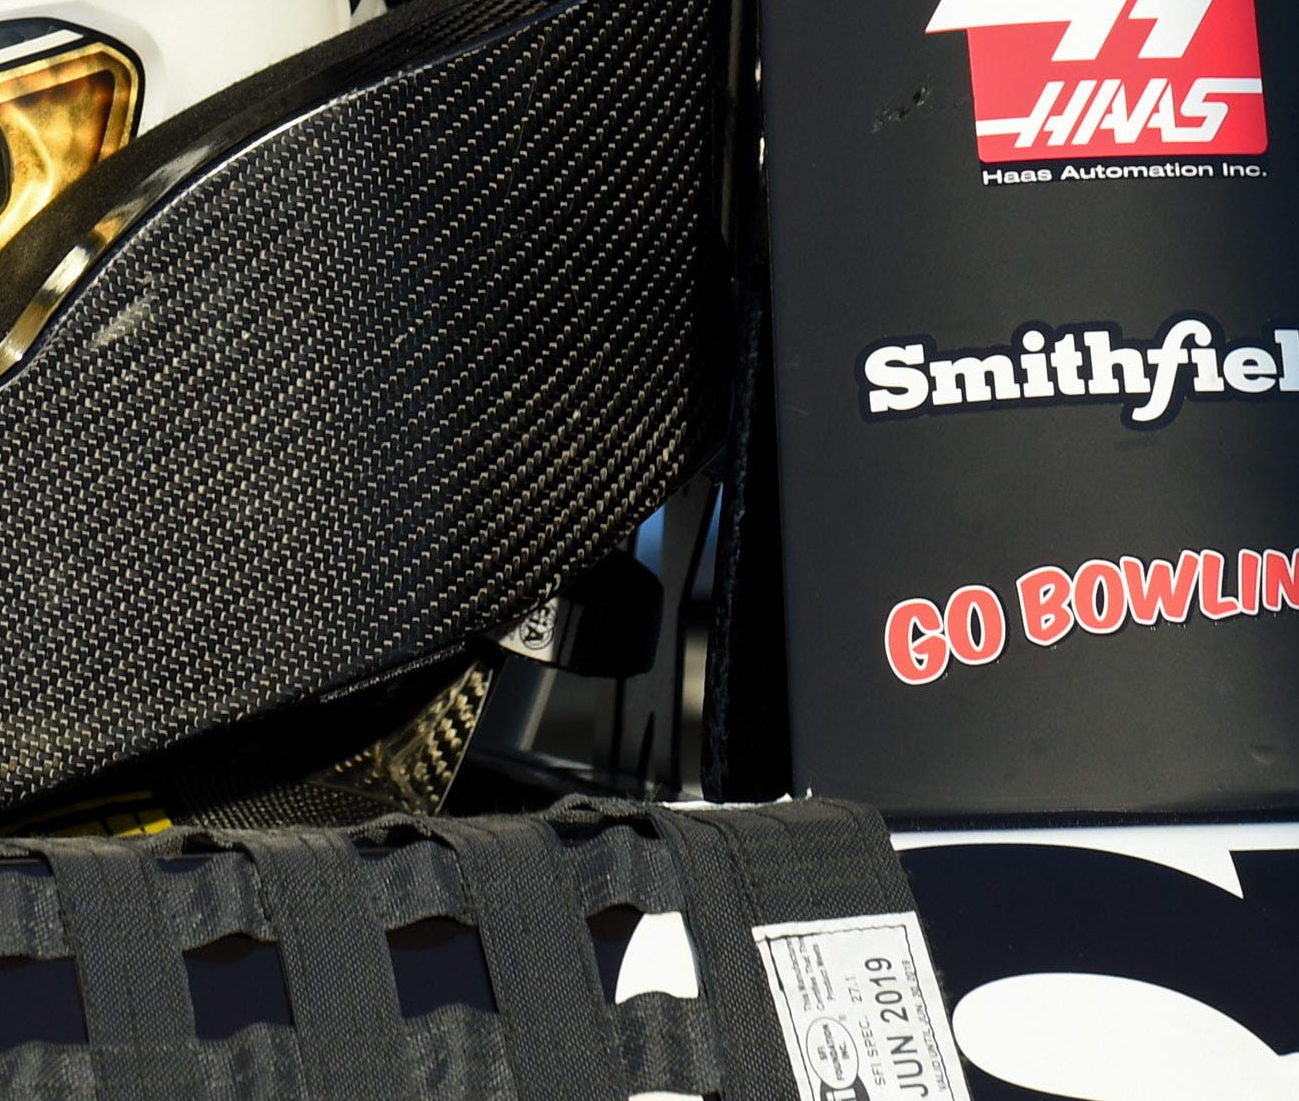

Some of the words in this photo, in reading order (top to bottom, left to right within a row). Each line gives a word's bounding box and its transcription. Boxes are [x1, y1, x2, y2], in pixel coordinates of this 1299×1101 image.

[975, 77, 1263, 149] HAAS
[982, 168, 1053, 186] Haas
[1060, 162, 1215, 182] Automation
[1222, 161, 1269, 179] Inc.
[863, 319, 1299, 422] Smithfiel
[884, 584, 1007, 686] GO
[1015, 547, 1299, 647] BOWLIN
[864, 956, 910, 1024] 2019
[822, 1023, 845, 1082] FOUNDATION
[858, 1015, 879, 1058] SPEC.
[886, 1034, 929, 1098] JUN
[870, 1062, 887, 1087] SFI
